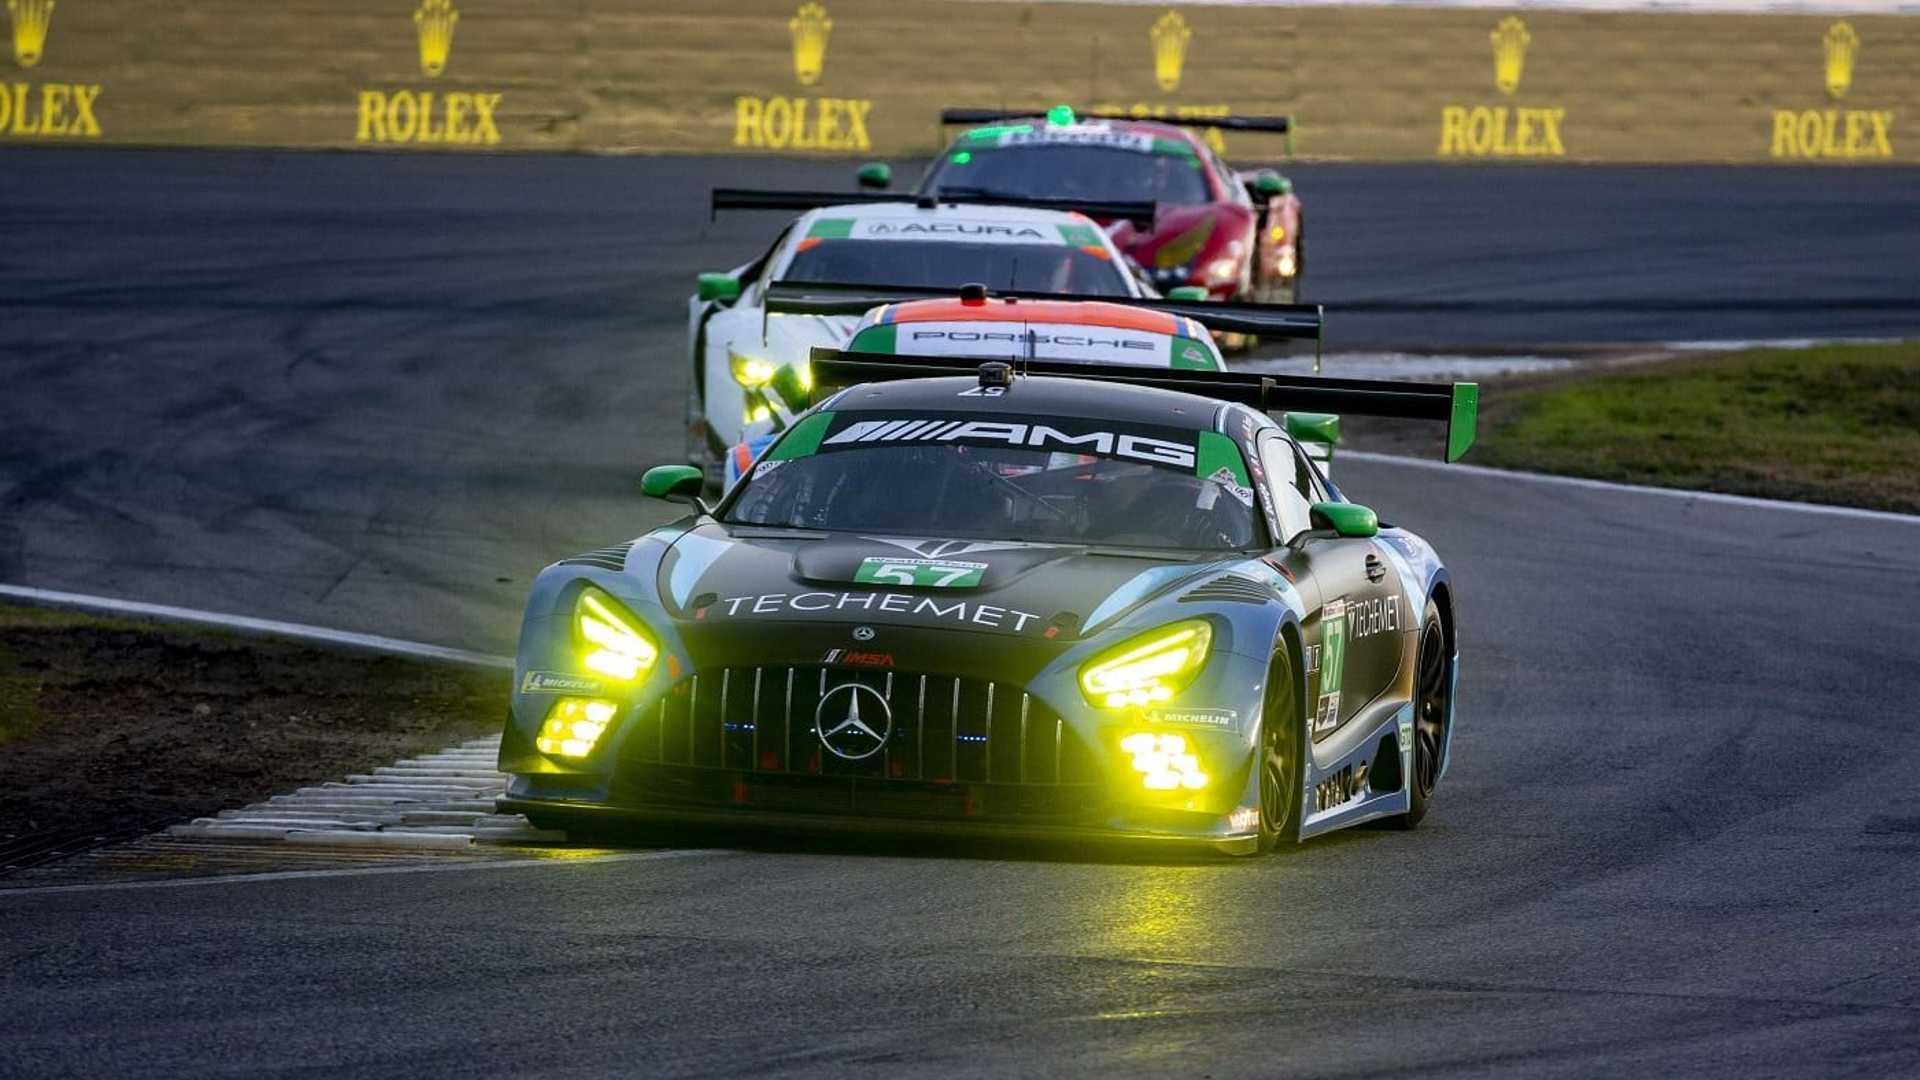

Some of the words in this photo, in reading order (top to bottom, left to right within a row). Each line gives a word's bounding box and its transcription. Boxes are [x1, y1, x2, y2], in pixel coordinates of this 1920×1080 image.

[355, 91, 501, 144] ROLEX
[734, 97, 871, 150] ROLEX
[1439, 106, 1565, 155] ROLEX
[1771, 110, 1893, 158] ROLEX
[900, 223, 1044, 238] ACURA
[912, 331, 1155, 351] PORSCHE
[873, 563, 974, 587] 57
[723, 592, 1040, 632] TECHEMET
[1354, 595, 1401, 638] TECHEMET
[1323, 618, 1344, 692] 57
[1163, 713, 1230, 726] MICHELIN
